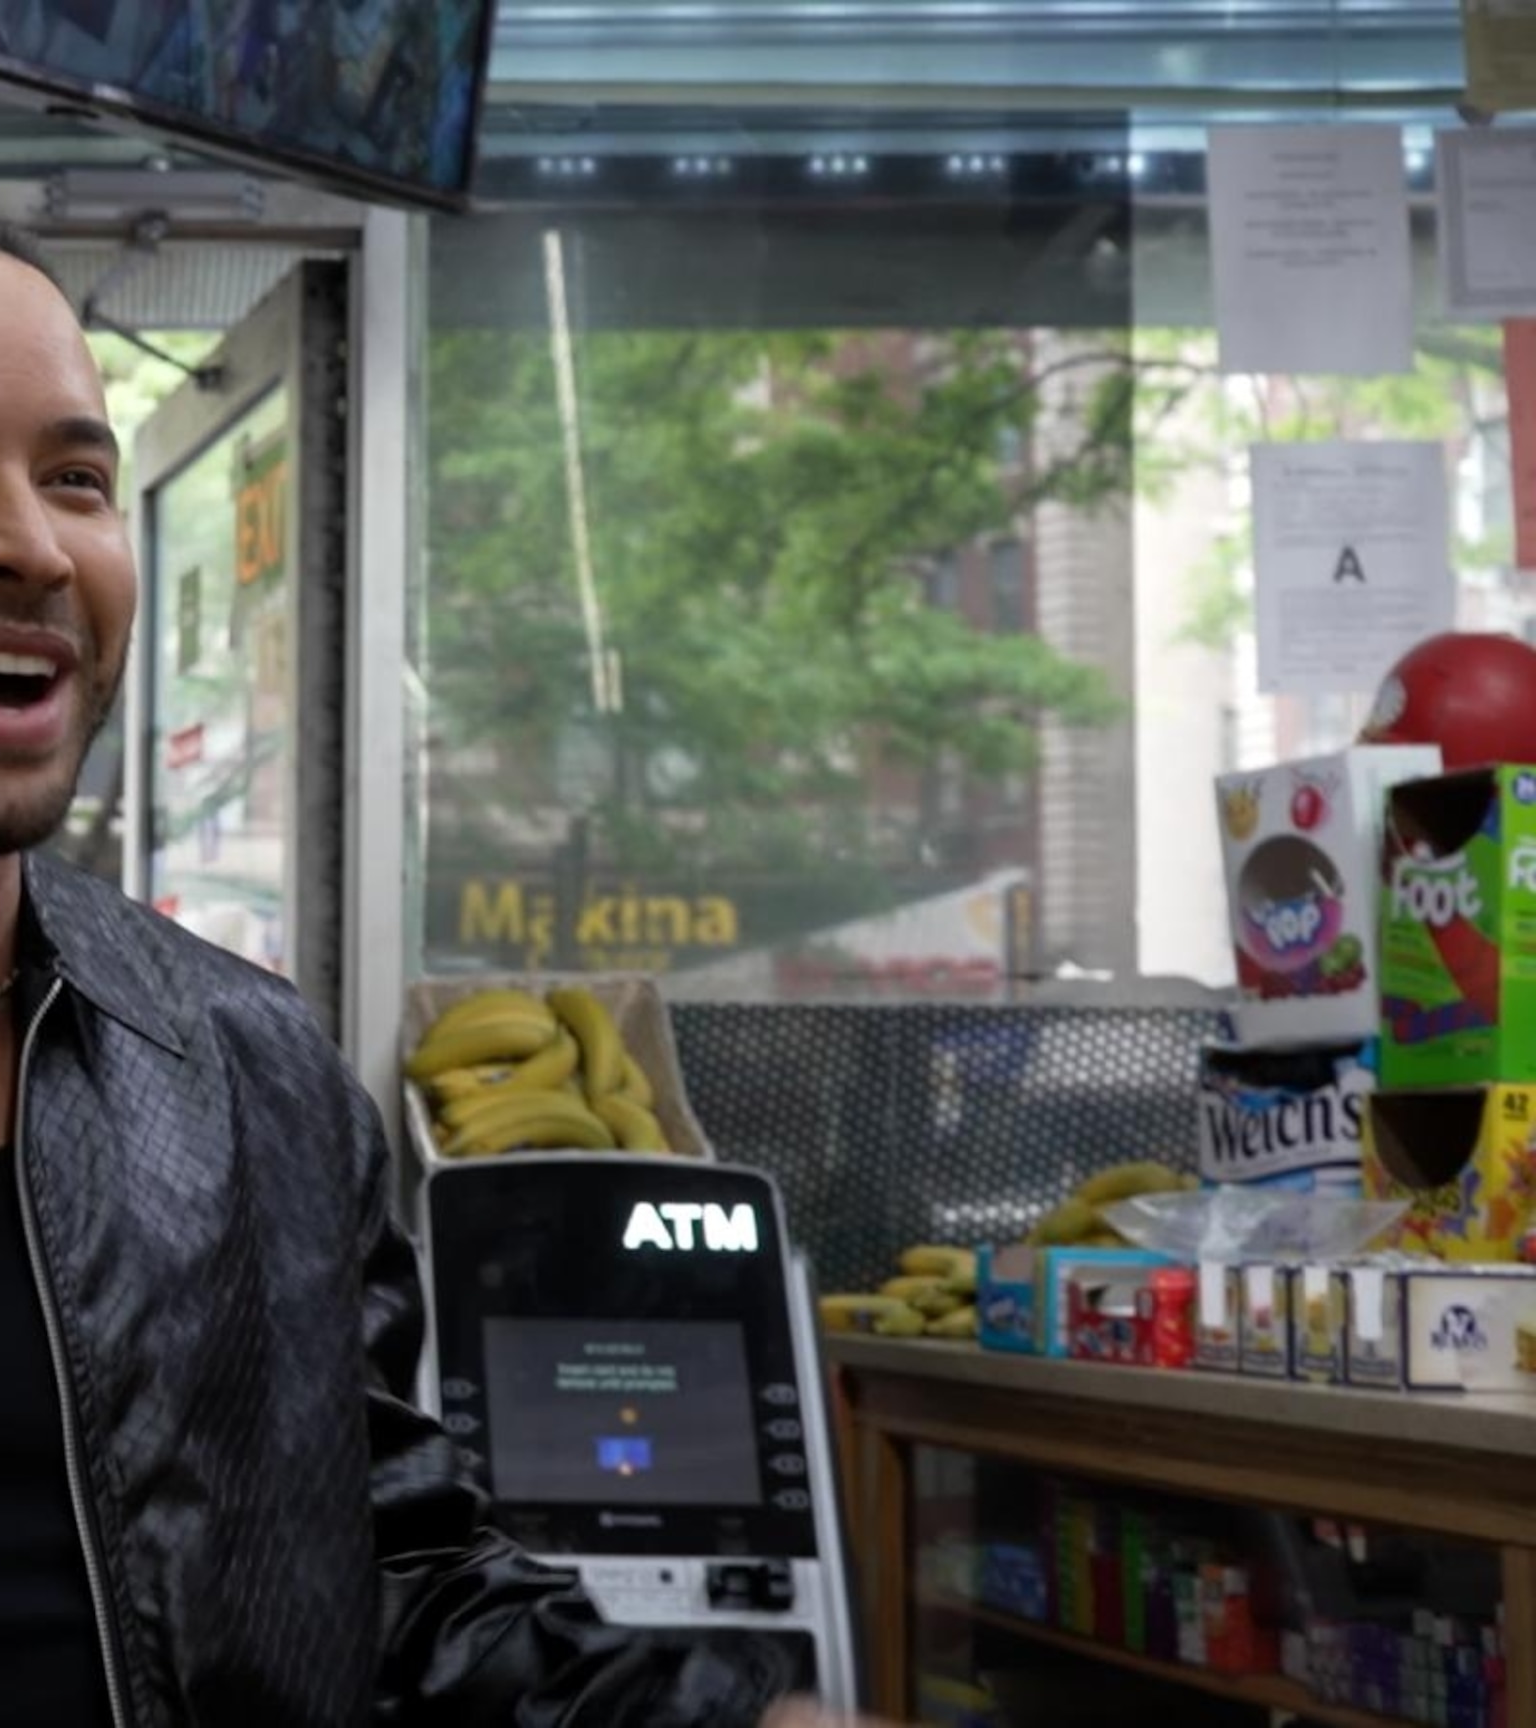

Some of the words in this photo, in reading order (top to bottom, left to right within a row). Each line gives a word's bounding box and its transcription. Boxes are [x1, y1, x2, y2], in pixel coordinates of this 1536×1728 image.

[1332, 546, 1366, 583] A
[461, 874, 737, 945] Mkina
[1208, 1091, 1362, 1163] Welchs
[622, 1203, 758, 1252] ATM
